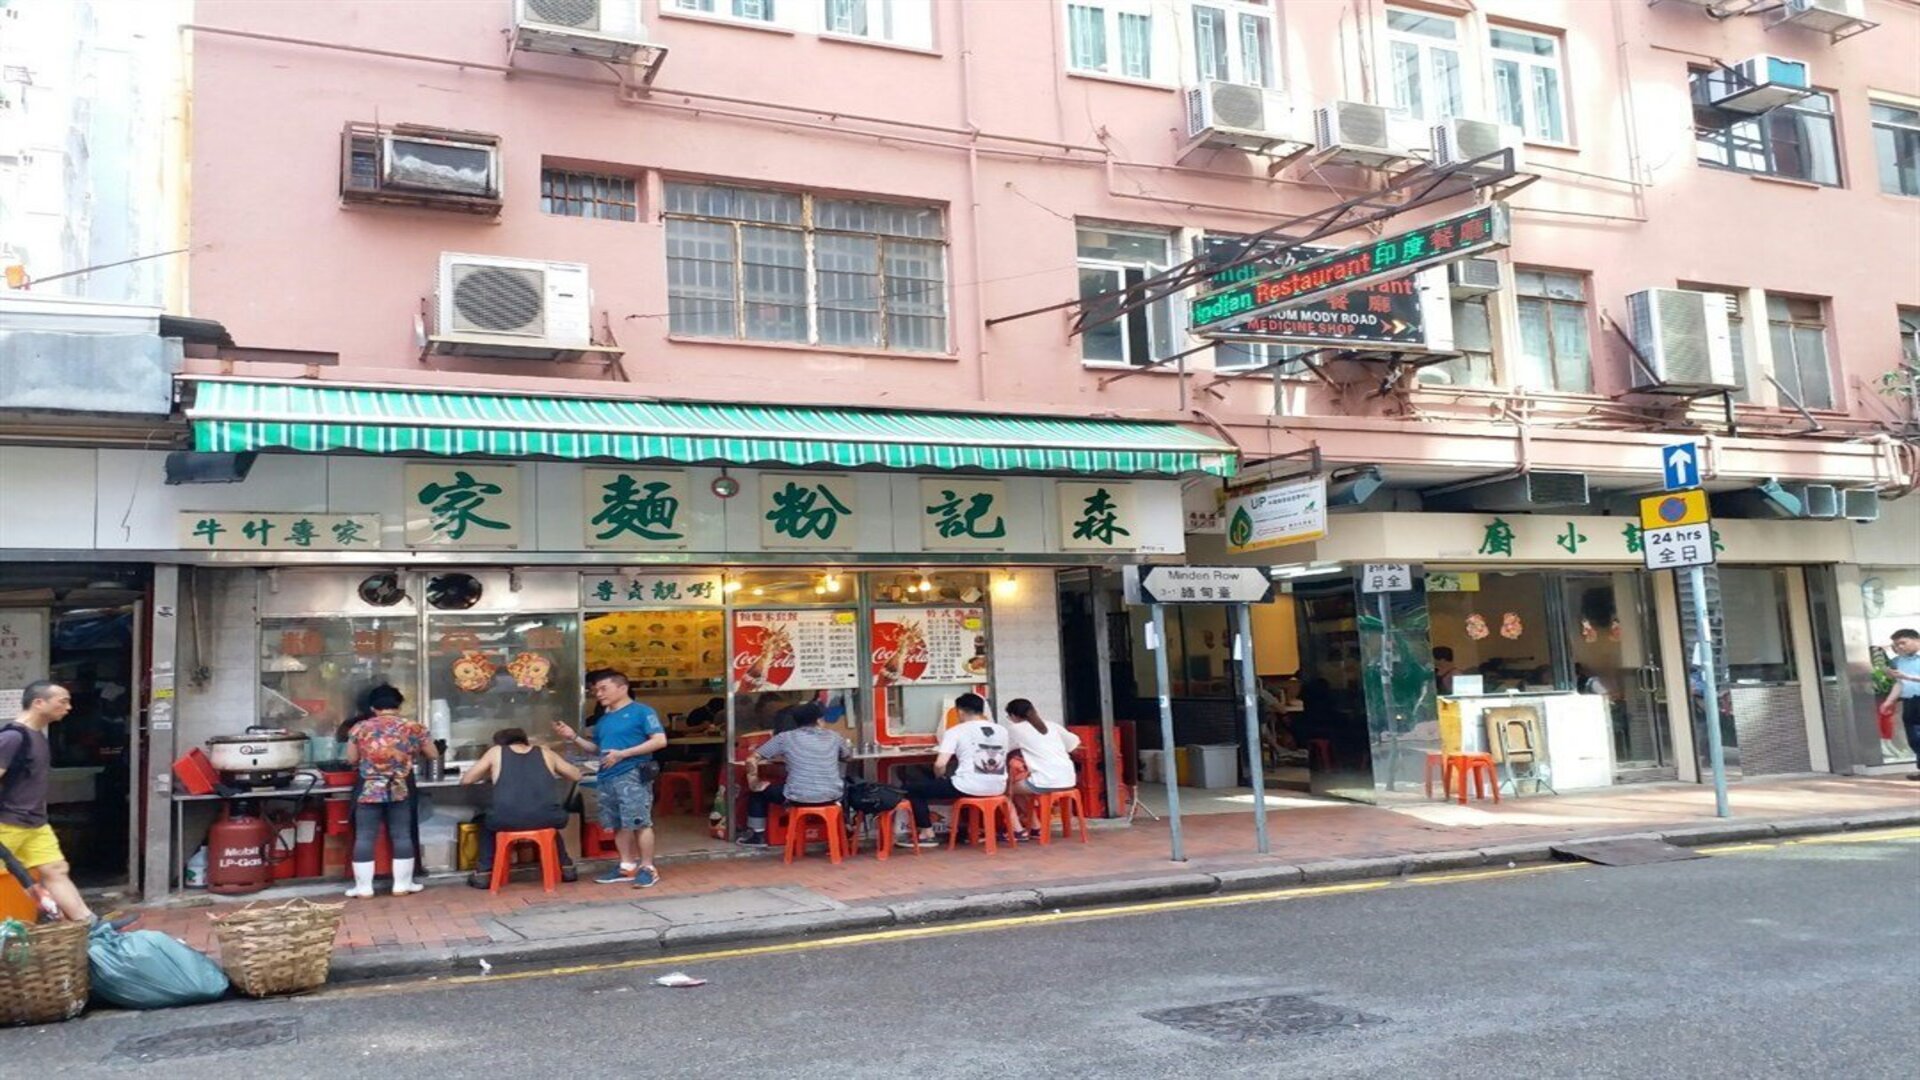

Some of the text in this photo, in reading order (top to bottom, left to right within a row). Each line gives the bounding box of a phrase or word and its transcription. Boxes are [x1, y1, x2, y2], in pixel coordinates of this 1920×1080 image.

[1255, 253, 1371, 303] Restaurant
[1300, 310, 1339, 323] MODY
[1341, 312, 1377, 325] ROAD
[1247, 318, 1356, 334] MEDICINE SHOP
[1651, 530, 1702, 545] 24 hrs
[1659, 544, 1698, 564] 全日
[1167, 570, 1240, 581] Minden Row
[224, 846, 260, 857] Mobil
